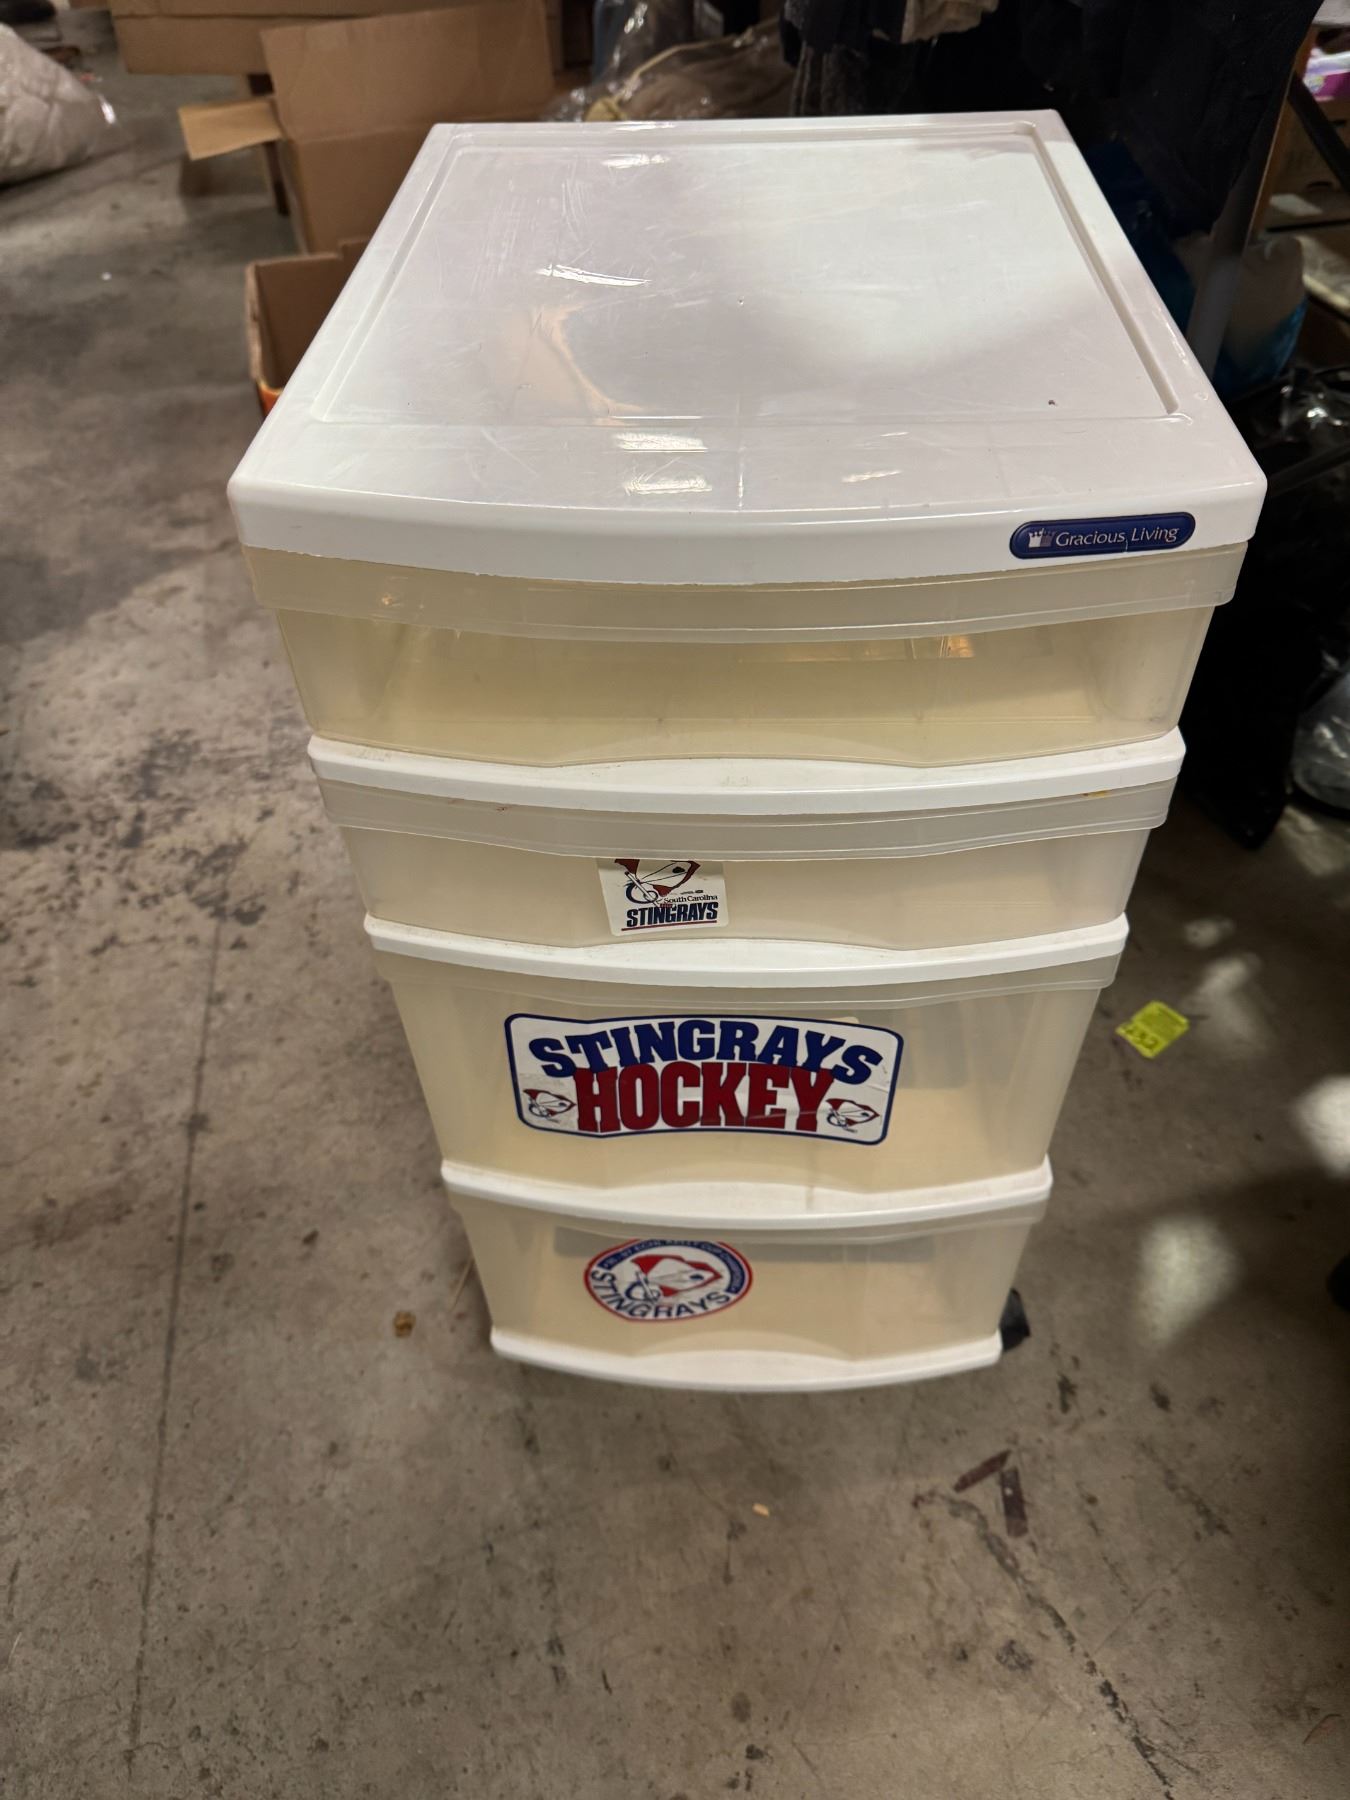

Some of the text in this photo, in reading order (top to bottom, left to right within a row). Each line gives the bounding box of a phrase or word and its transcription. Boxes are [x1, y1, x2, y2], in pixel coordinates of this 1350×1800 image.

[1055, 527, 1180, 547] Gracious Living
[626, 901, 719, 928] STINGRAYS
[663, 894, 718, 904] South Carolina
[528, 1019, 884, 1085] STINGRAYS
[572, 1060, 836, 1133] HOCKEY
[590, 1270, 731, 1318] STINGRAYS
